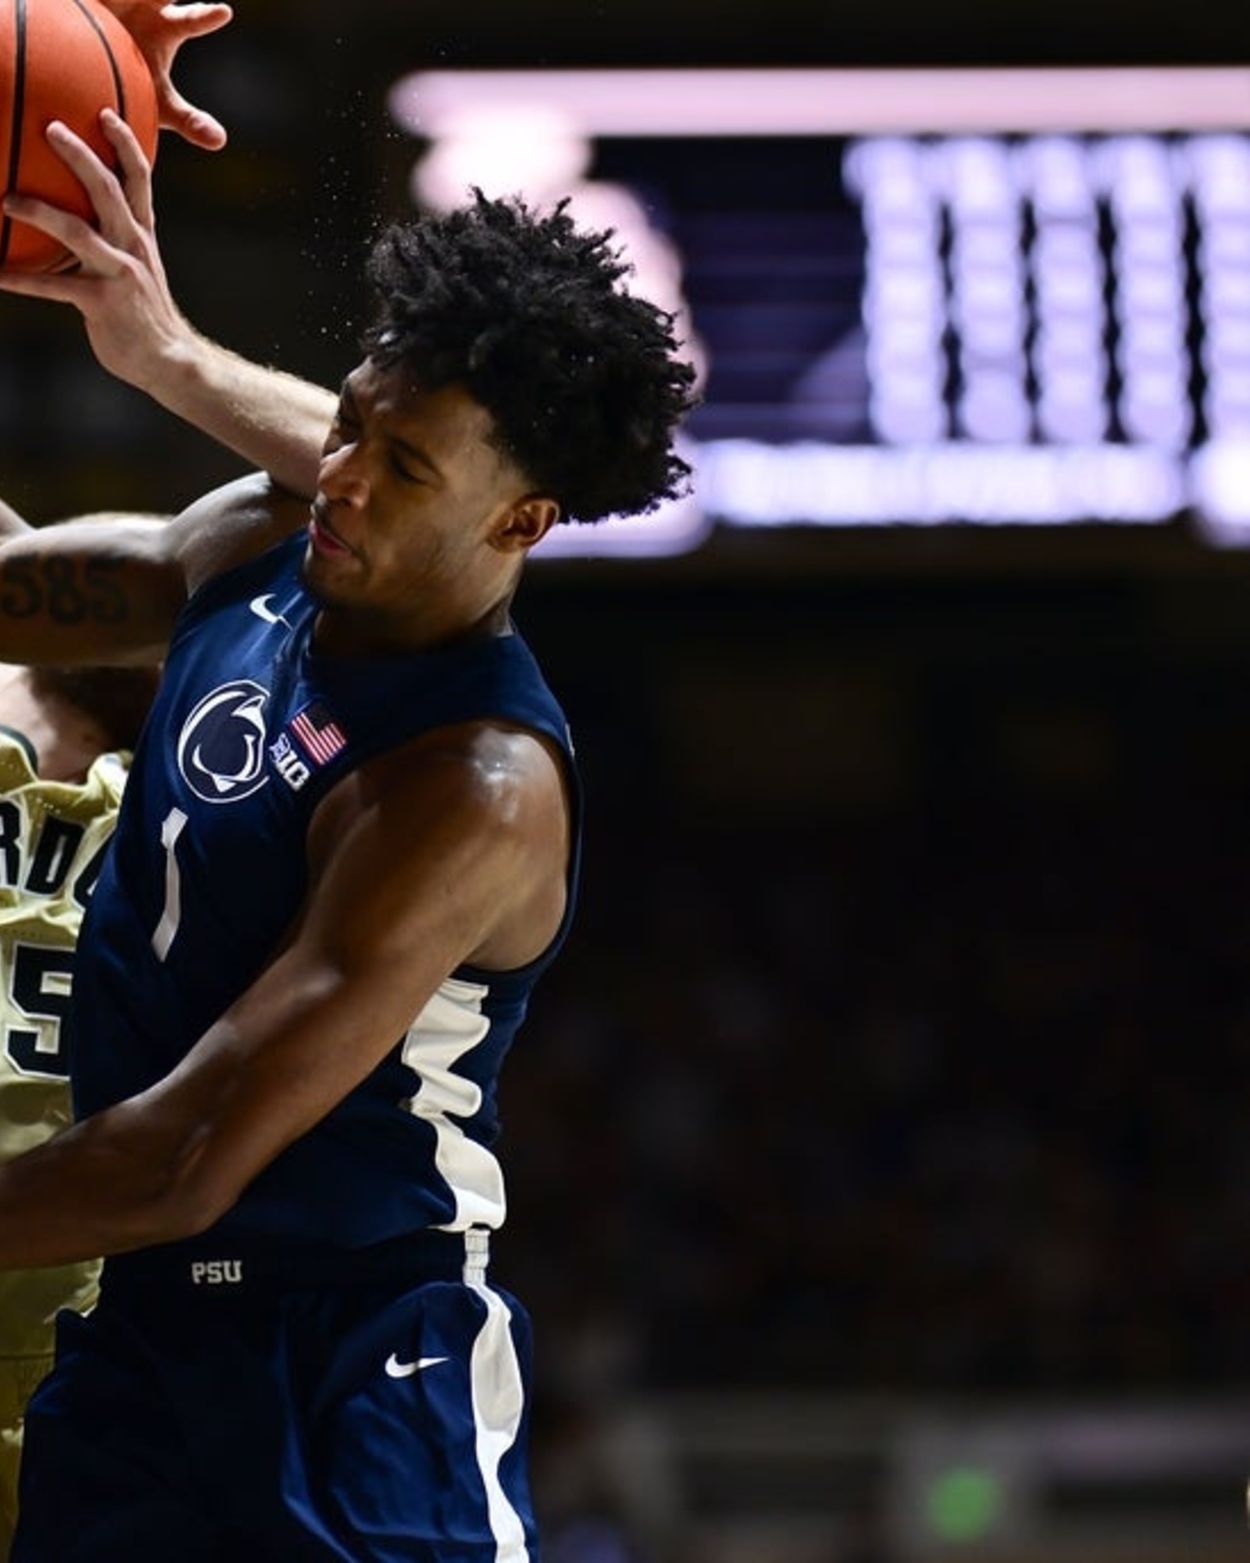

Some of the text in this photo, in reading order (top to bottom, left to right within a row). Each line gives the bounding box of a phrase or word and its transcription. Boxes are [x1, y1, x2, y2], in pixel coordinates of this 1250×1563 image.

[0, 553, 129, 625] 585
[152, 807, 188, 963] 1
[191, 1260, 242, 1284] PSU
